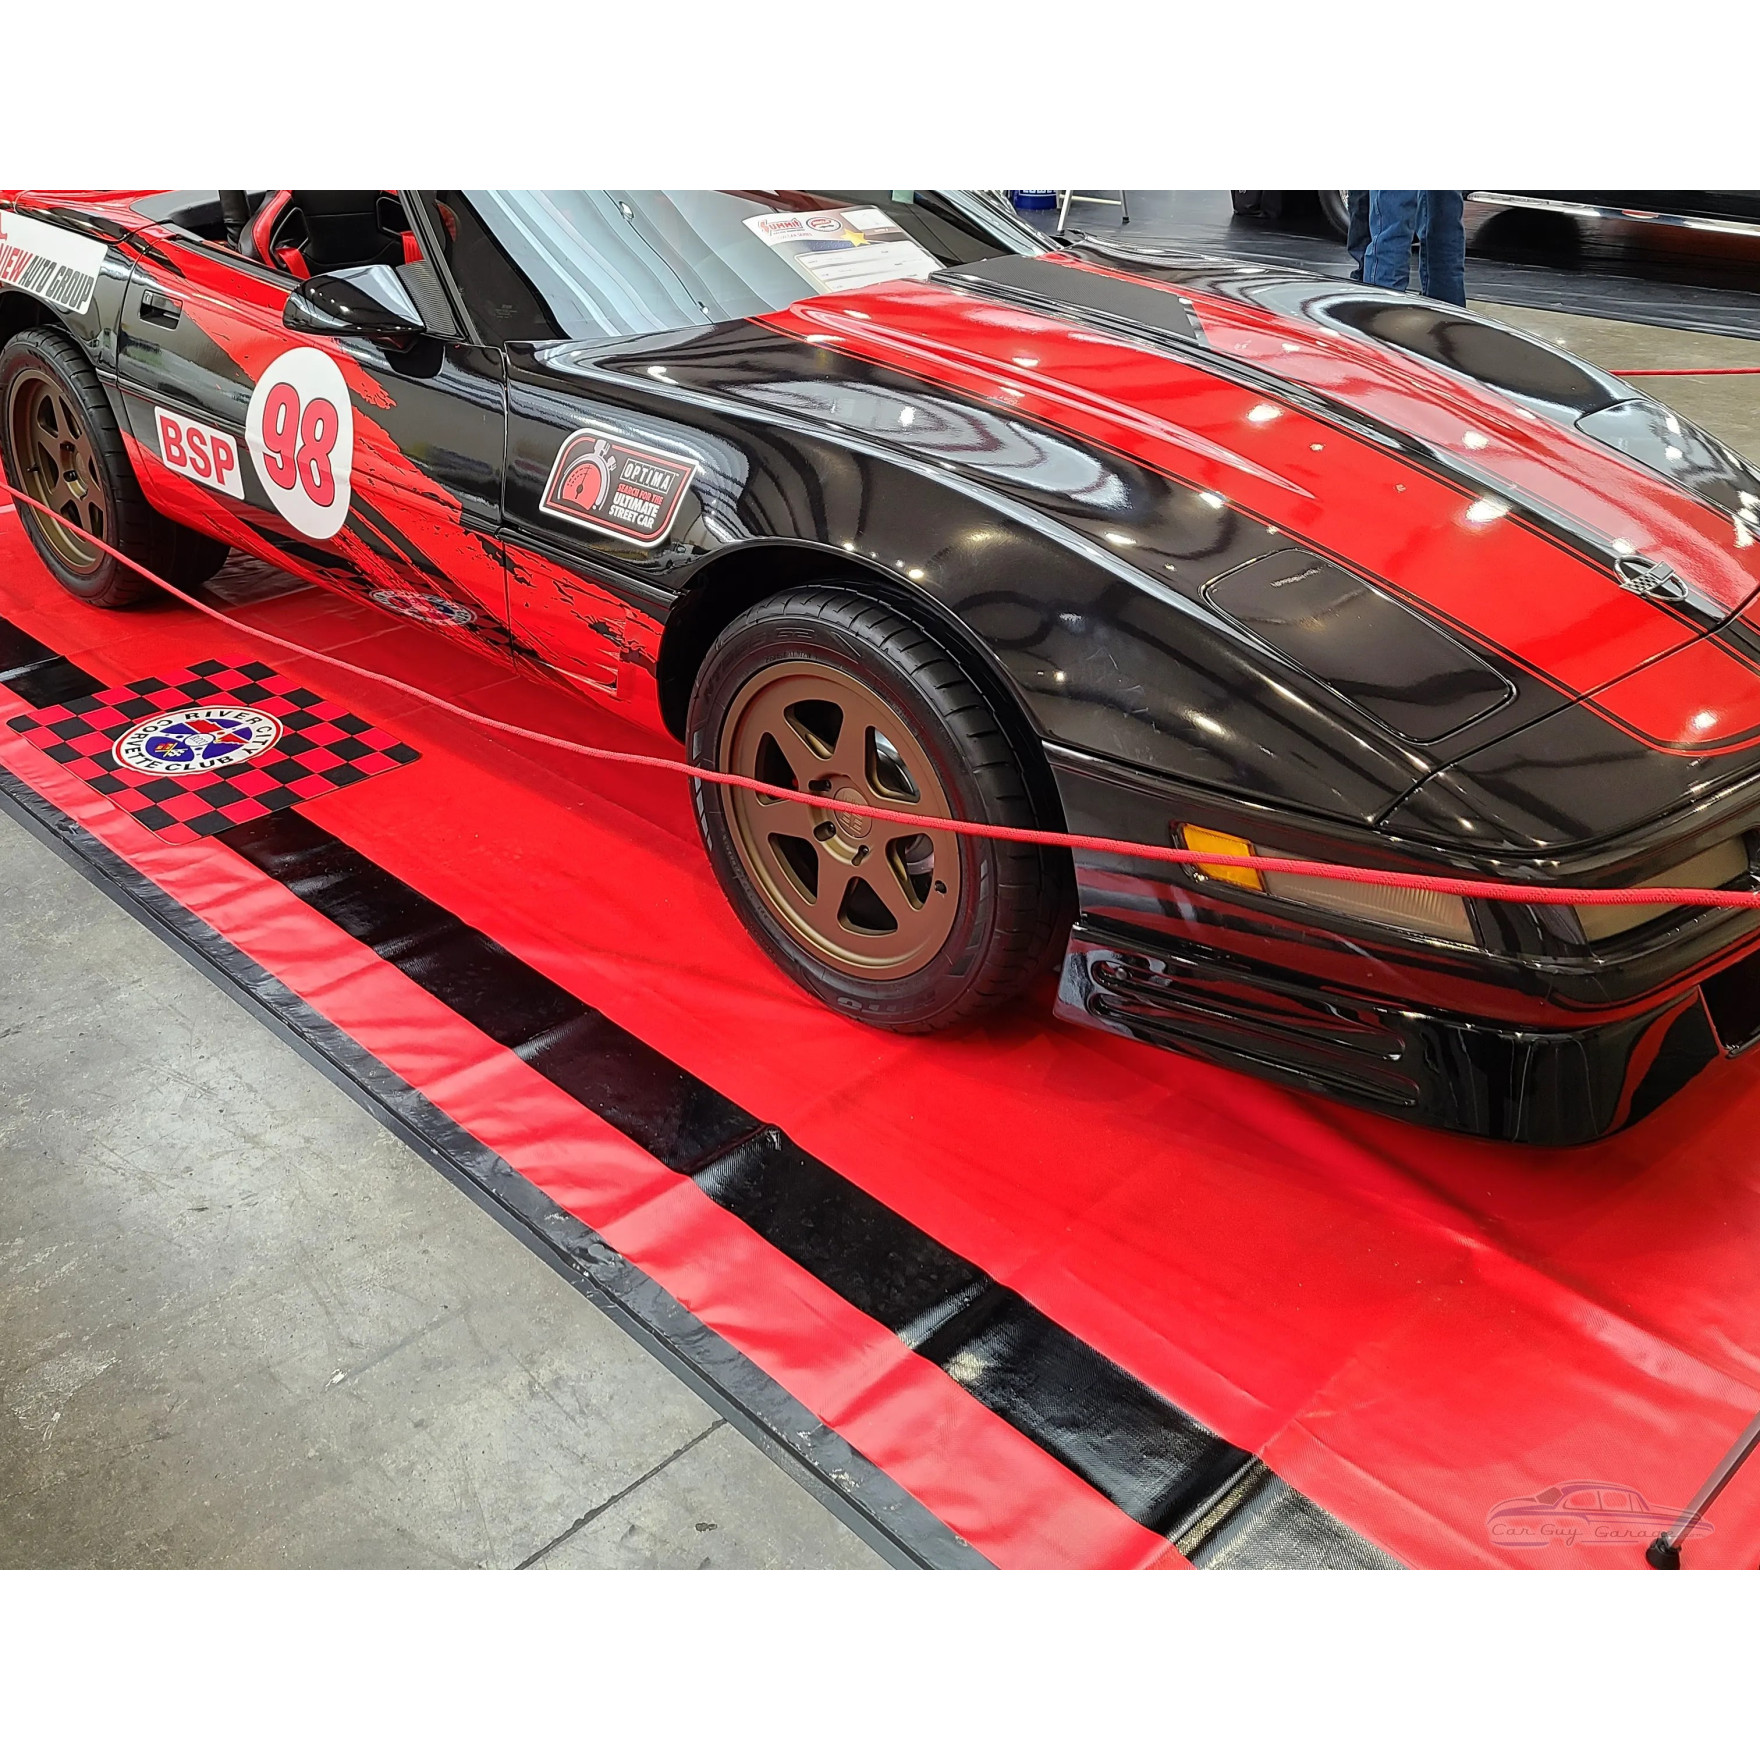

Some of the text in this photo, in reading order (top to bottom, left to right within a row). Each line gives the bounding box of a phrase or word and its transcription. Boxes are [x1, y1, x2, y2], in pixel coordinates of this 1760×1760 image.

[18, 254, 57, 293] AUTO
[45, 265, 95, 310] GROUP
[160, 415, 236, 486] BSP
[262, 382, 338, 506] 98
[617, 483, 664, 505] SEARCH FOR THE
[624, 463, 671, 490] OPTIMA
[608, 504, 655, 529] STREET CAR
[613, 491, 660, 518] ULTIMATE
[125, 719, 234, 772] CORVETTE CLUB
[184, 710, 273, 755] RIVER CITY
